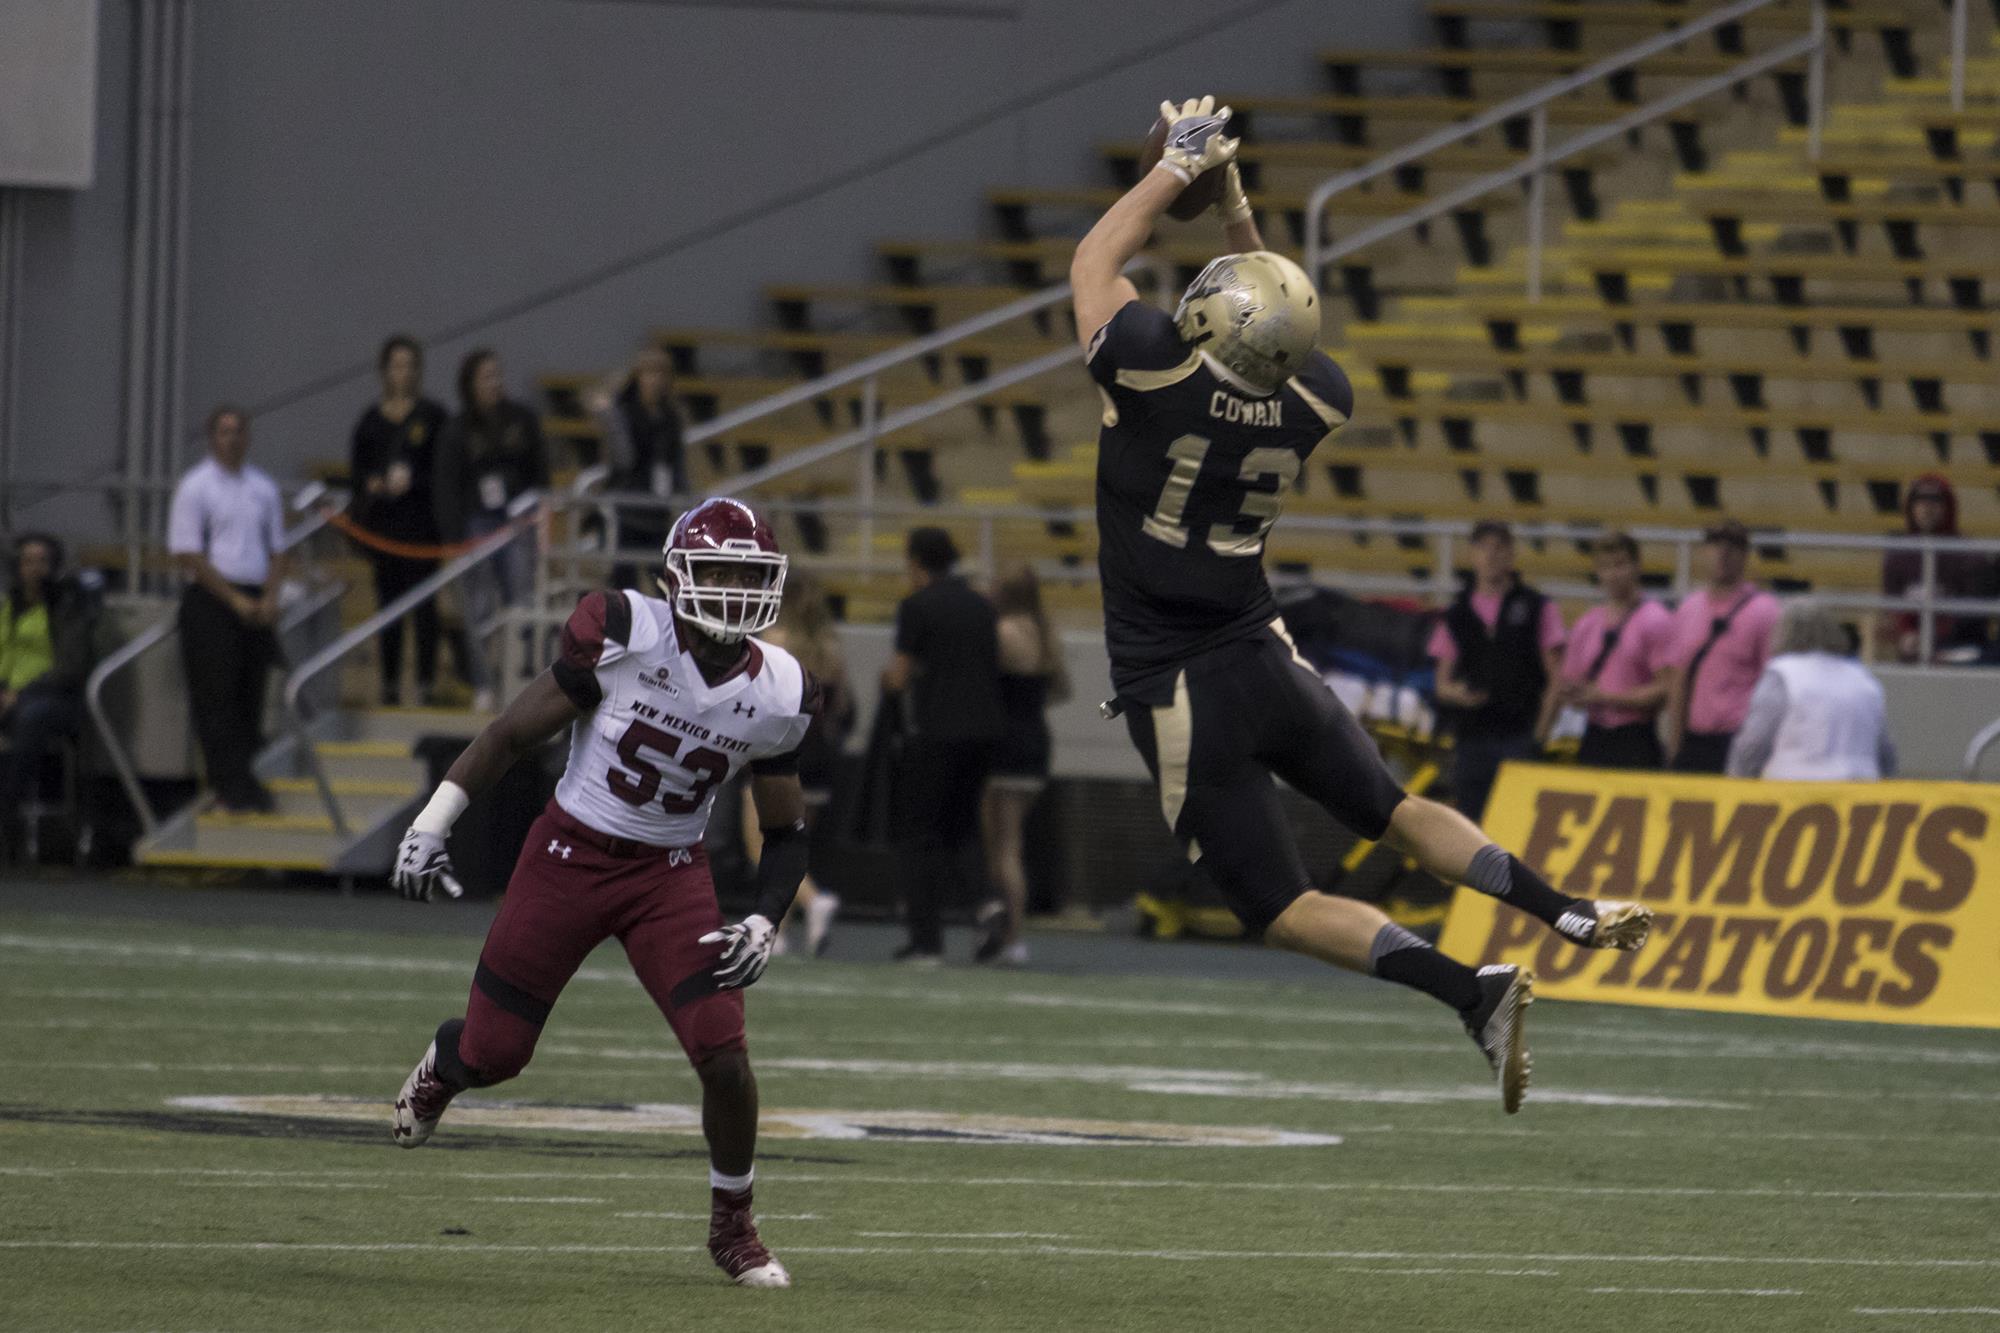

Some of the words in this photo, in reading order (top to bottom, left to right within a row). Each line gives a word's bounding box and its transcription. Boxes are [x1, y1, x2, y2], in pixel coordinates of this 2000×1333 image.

[1209, 390, 1282, 427] COWAN
[1142, 434, 1301, 556] 13
[606, 719, 730, 815] 53
[630, 699, 659, 719] NEW
[661, 713, 711, 740] MEXICO
[712, 734, 752, 753] STATE
[1522, 789, 1988, 913] FAMOUS
